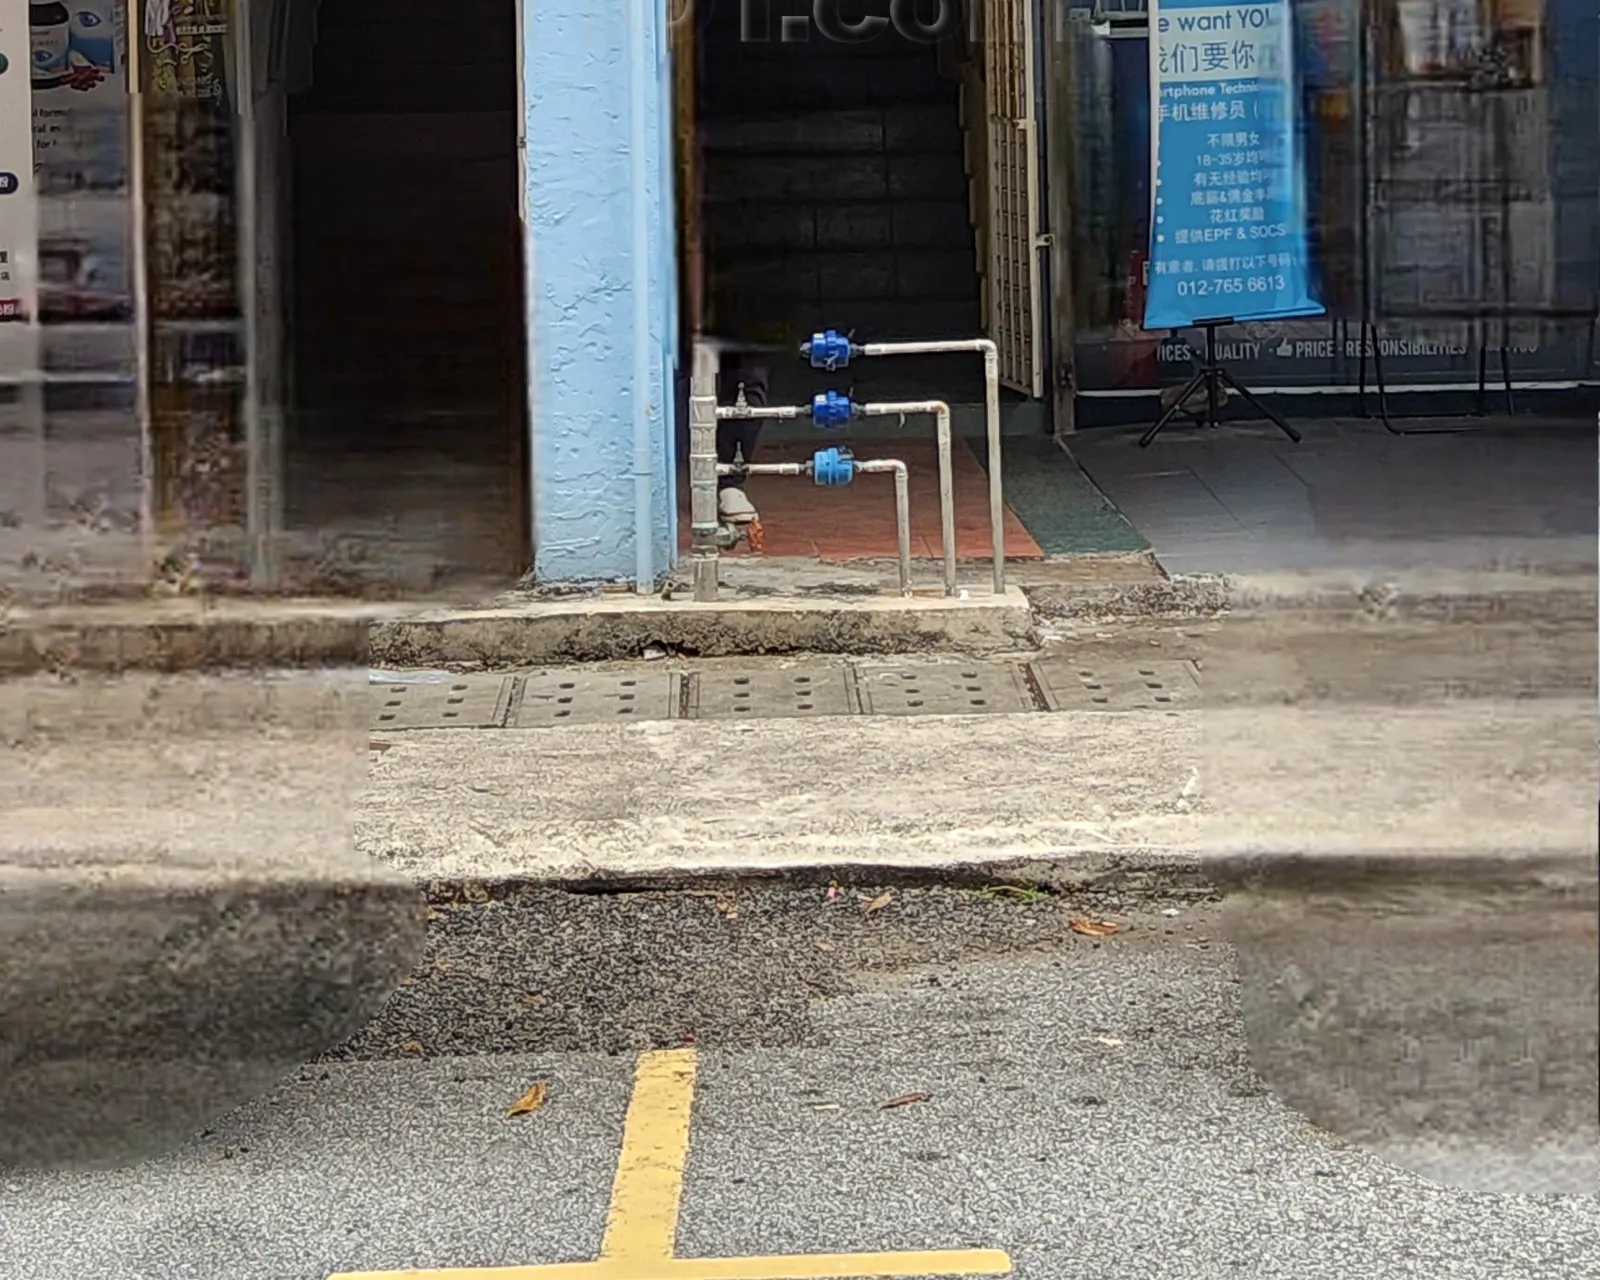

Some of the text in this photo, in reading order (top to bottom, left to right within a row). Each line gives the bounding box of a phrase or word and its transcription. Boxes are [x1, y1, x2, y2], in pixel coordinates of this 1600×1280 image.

[1177, 10, 1232, 32] want
[1236, 227, 1247, 240] &
[1177, 274, 1286, 297] 012-765 6613
[1204, 341, 1260, 361] UALITY
[1296, 340, 1335, 358] PRICE
[1346, 338, 1467, 358] RESONSIBILITIES
